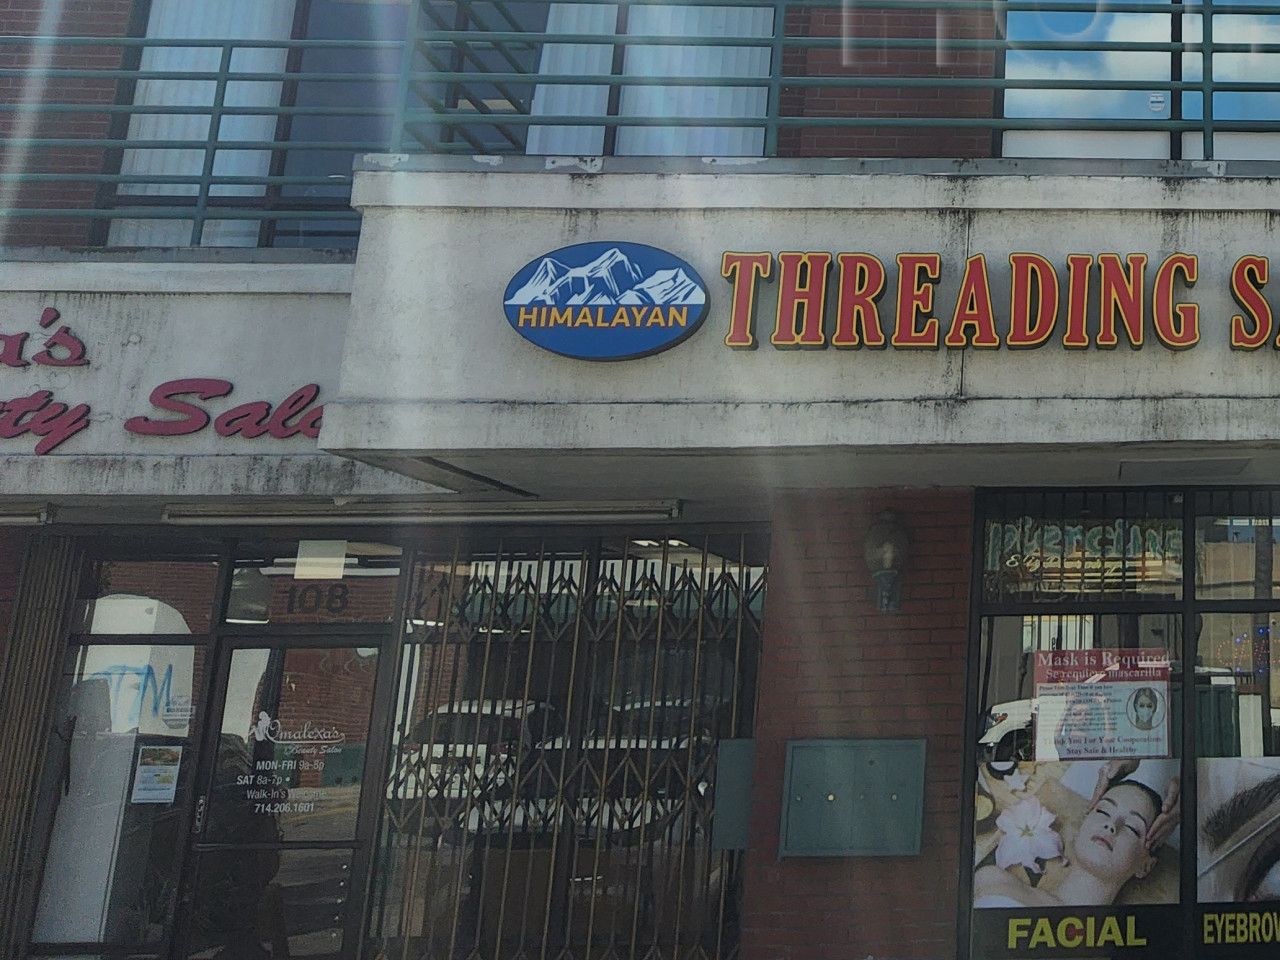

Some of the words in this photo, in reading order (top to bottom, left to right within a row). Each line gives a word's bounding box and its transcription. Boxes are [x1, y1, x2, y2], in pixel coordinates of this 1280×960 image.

[720, 250, 1200, 350] THREADING
[517, 306, 688, 327] HIMALAYAN
[285, 584, 349, 614] 108
[1039, 651, 1079, 667] Mask
[1085, 651, 1097, 666] is
[1102, 650, 1170, 670] Required
[1108, 667, 1162, 678] mascarilla
[256, 759, 297, 771] MON-FRI
[236, 774, 256, 785] SAT
[1007, 915, 1148, 950] FACIAL
